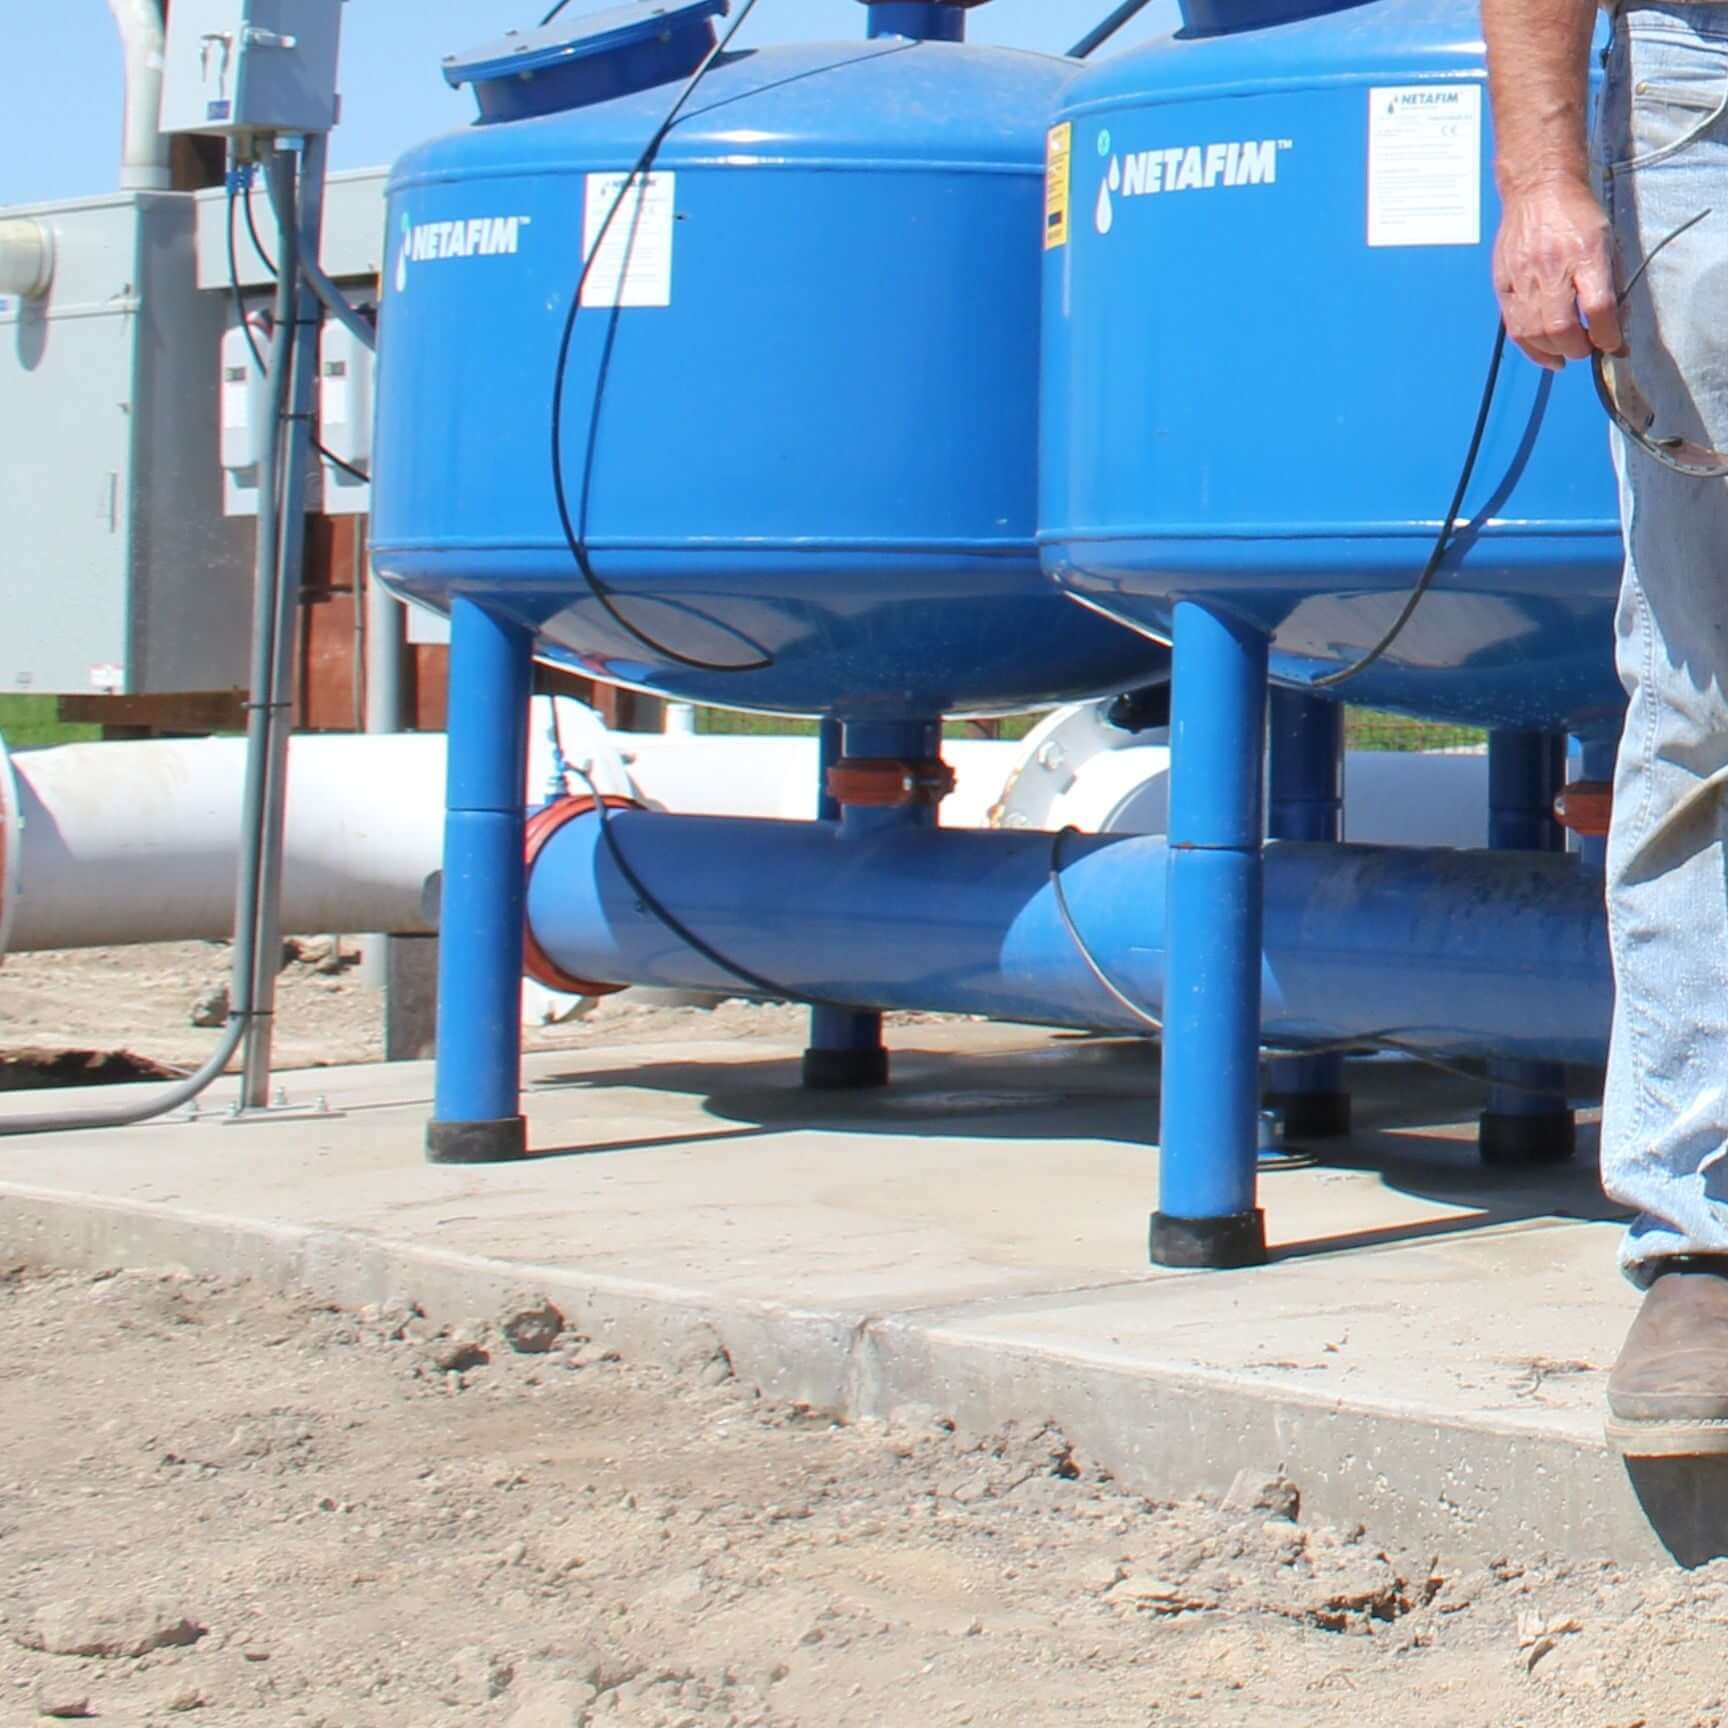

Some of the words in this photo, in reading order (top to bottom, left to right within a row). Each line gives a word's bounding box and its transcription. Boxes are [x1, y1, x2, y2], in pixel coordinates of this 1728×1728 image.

[1401, 92, 1459, 105] NETAFIM
[1122, 140, 1277, 196] NETAFIM
[412, 217, 519, 261] NETAFIM
